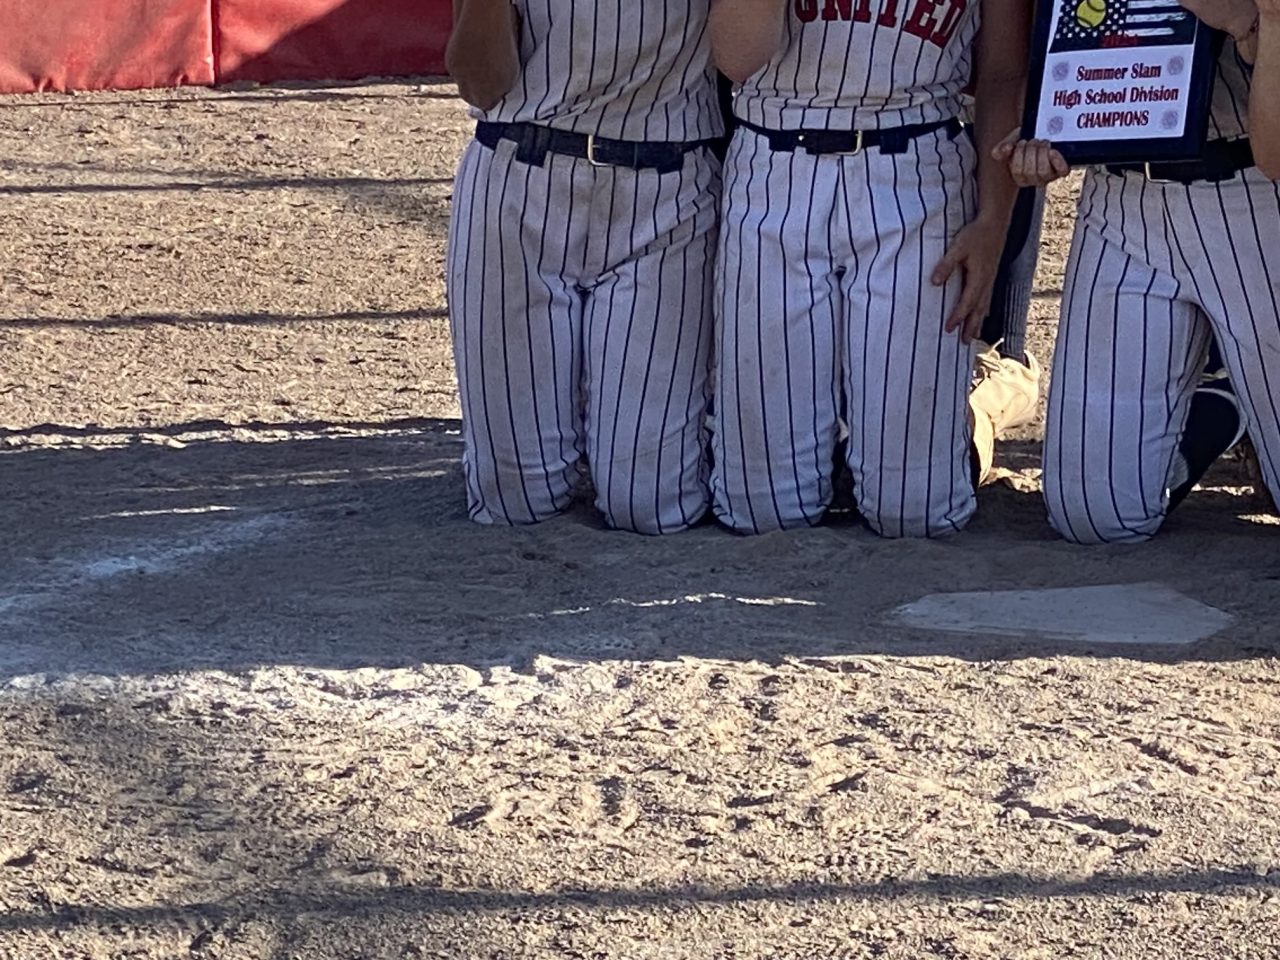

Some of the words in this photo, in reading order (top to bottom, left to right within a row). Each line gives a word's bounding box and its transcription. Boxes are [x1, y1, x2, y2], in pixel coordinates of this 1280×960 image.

[1076, 66, 1128, 82] Summer
[1131, 63, 1162, 79] Slam
[1053, 90, 1081, 109] High
[1085, 87, 1127, 105] School
[1130, 85, 1179, 102] Division
[1077, 110, 1149, 129] CHAMPIONS
